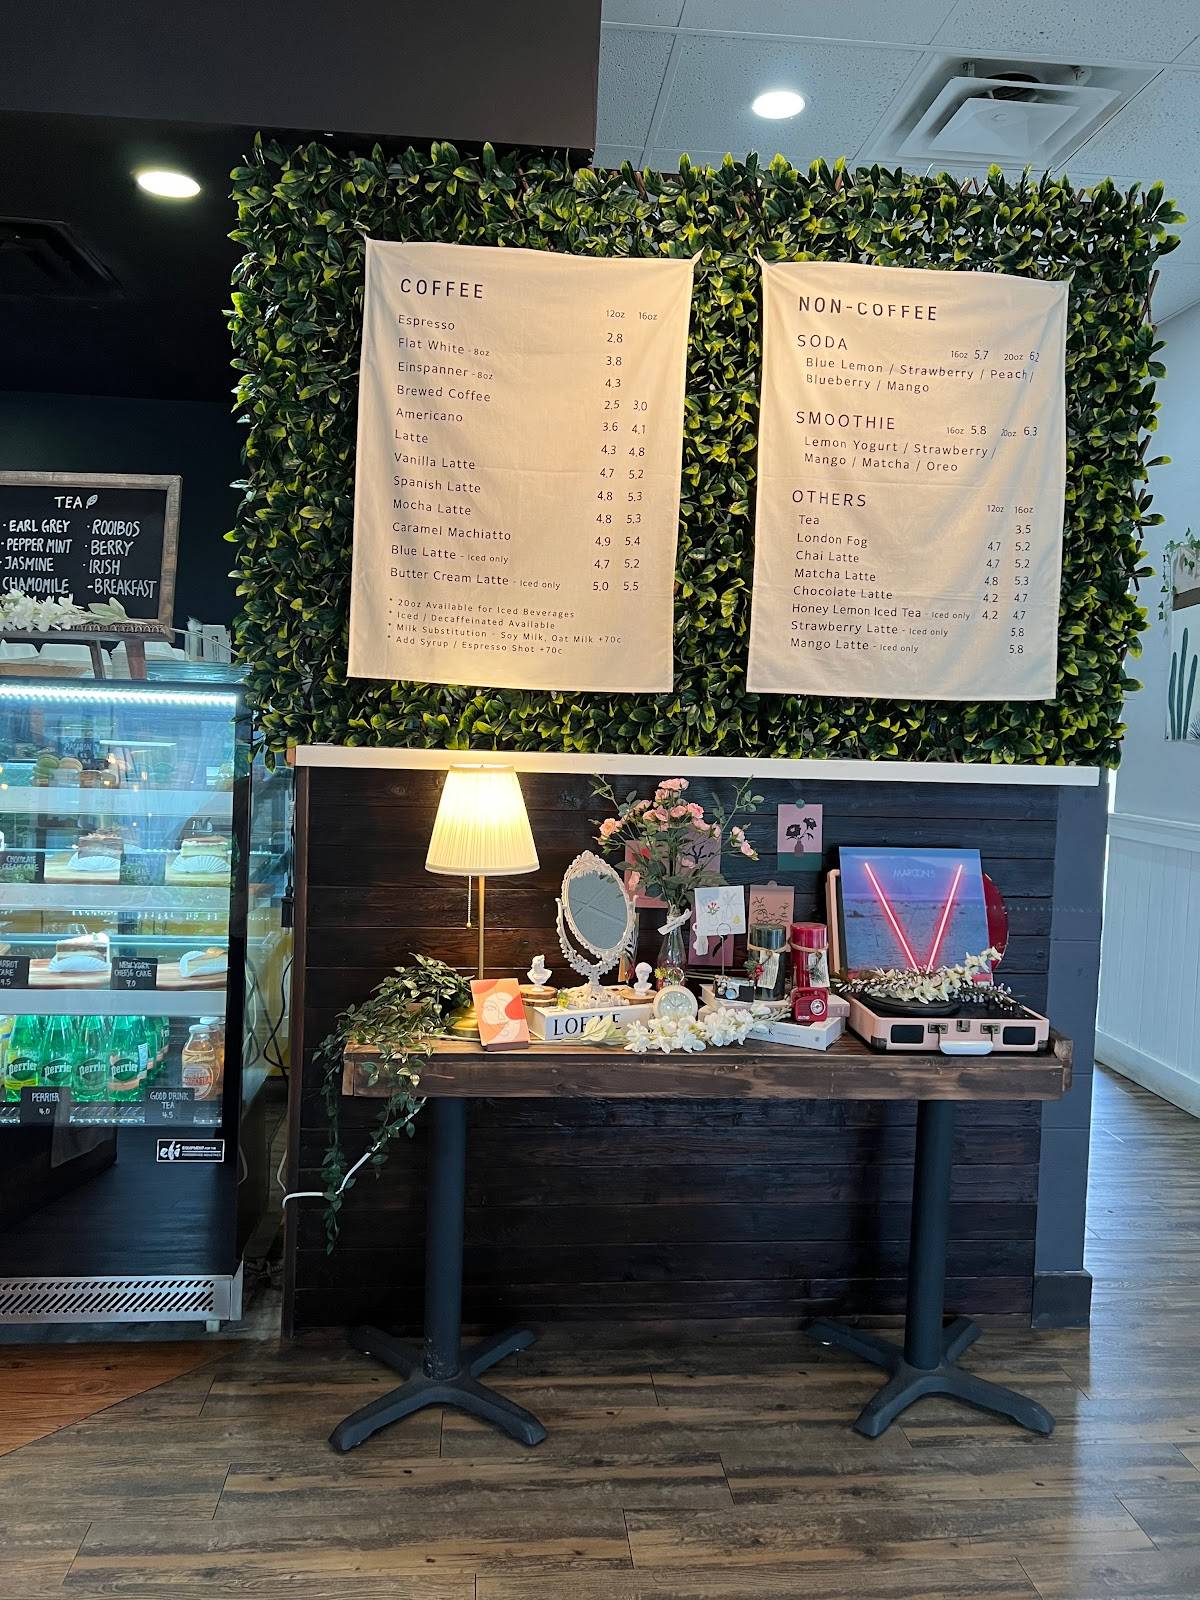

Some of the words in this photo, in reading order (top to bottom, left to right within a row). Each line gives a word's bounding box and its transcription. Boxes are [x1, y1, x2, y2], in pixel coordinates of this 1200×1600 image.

[401, 278, 483, 298] COFFEE
[606, 310, 625, 318] 12oz
[639, 312, 657, 320] 16oz
[799, 296, 936, 320] NON-COFFEE
[398, 315, 454, 330] Espresso
[607, 333, 622, 343] 2.8
[798, 334, 848, 350] SODA
[399, 337, 422, 348] Flat
[428, 340, 464, 354] White
[606, 356, 622, 366] 3.8
[952, 350, 968, 358] 16oz
[974, 350, 988, 360] 5.7
[398, 362, 468, 378] Einspanner
[806, 357, 834, 368] Blue
[842, 360, 882, 372] Lemon
[900, 366, 973, 380] Strawberry
[991, 369, 1027, 380] Peach
[605, 378, 620, 388] 4.3
[807, 374, 870, 390] Blueberry
[888, 381, 929, 394] Mango
[398, 385, 442, 396] Brewed
[448, 389, 490, 402] Coffee
[604, 400, 619, 410] 2.5
[634, 400, 647, 411] 3.0
[396, 408, 462, 422] Americano
[796, 411, 894, 430] SMOOTHIE
[603, 422, 618, 431] 3.6
[632, 424, 645, 434] 4.1
[971, 426, 986, 435] 5.8
[1024, 426, 1037, 436] 6.3
[396, 429, 428, 443] Latte
[601, 444, 616, 454] 4.3
[629, 447, 644, 457] 4.8
[805, 436, 846, 448] Lemon
[853, 440, 898, 455] Yogurt
[914, 444, 987, 458] Strawberry
[394, 452, 436, 466] Vanilla
[442, 458, 475, 470] Latte
[805, 453, 846, 467] Mango
[862, 458, 909, 469] Matcha
[927, 462, 957, 471] Oreo
[600, 468, 614, 478] 4.7
[629, 469, 643, 479] 5.2
[394, 475, 441, 490] Spanish
[448, 481, 480, 493] Latte
[54, 496, 83, 509] TEA
[598, 491, 612, 501] 4.8
[628, 492, 642, 502] 5.3
[792, 490, 866, 507] OTHERS
[394, 499, 432, 512] Mocha
[438, 504, 471, 515] Latte
[988, 505, 1004, 513] 12oz
[1015, 506, 1033, 514] 16oz
[9, 519, 38, 533] EARL
[41, 519, 71, 533] GREY
[596, 514, 611, 524] 4.8
[626, 514, 641, 524] 5.3
[798, 515, 819, 525] Tea
[92, 519, 140, 538] ROOIBOS
[393, 522, 442, 536] Caramel
[448, 528, 510, 540] Machiatto
[1016, 524, 1031, 534] 3.5
[7, 538, 44, 552] PEPPER
[46, 539, 73, 554] MINT
[595, 537, 610, 547] 4.9
[625, 536, 640, 546] 5.4
[798, 532, 841, 544] London
[847, 536, 867, 548] Fog
[988, 542, 1001, 551] 4.7
[1016, 542, 1030, 551] 5.2
[90, 540, 134, 556] BERRY
[392, 545, 416, 556] Blue
[423, 547, 456, 559] Latte
[489, 556, 509, 565] only
[796, 550, 823, 560] Chai
[829, 552, 859, 563] Latte
[986, 558, 1000, 568] 4.7
[1015, 559, 1030, 568] 5.2
[4, 556, 54, 572] JASMINE
[89, 559, 121, 576] IRISH
[594, 560, 610, 569] 4.7
[625, 559, 639, 568] 5.2
[391, 568, 428, 579] Butter
[434, 571, 471, 582] Cream
[477, 574, 508, 585] Latte
[795, 568, 840, 578] Matcha
[846, 570, 875, 581] Latte
[984, 576, 998, 586] 4.8
[1015, 576, 1028, 586] 5.3
[2, 576, 69, 594] CHAMOMILE
[593, 582, 608, 591] 5.0
[624, 581, 638, 591] 5.5
[794, 586, 856, 597] Chocolate
[861, 589, 892, 599] Latte
[983, 593, 998, 602] 4.2
[1014, 593, 1028, 603] 4.7
[398, 599, 421, 607] 20oz
[426, 602, 472, 611] Available
[523, 608, 574, 619] Beverages
[793, 603, 828, 616] Honey
[833, 604, 870, 615] Lemon
[874, 606, 897, 616] Iced
[902, 608, 921, 617] Tea
[982, 610, 998, 620] 4.2
[1013, 610, 1026, 620] 4.7
[432, 614, 503, 626] Decaffeinated
[509, 620, 554, 629] Available
[397, 624, 416, 632] Milk
[422, 626, 486, 637] Substitution
[501, 632, 518, 641] Soy
[792, 621, 862, 637] Strawberry
[867, 624, 898, 634] Latte
[1011, 628, 1024, 637] 5.8
[396, 636, 414, 644] Add
[421, 638, 448, 648] Syrup
[462, 642, 506, 651] Espresso
[512, 644, 534, 652] Shot
[791, 638, 830, 650] Mango
[836, 640, 868, 650] Latte
[1010, 644, 1023, 654] 5.8
[31, 1092, 60, 1103] PERRIER
[150, 1091, 167, 1101] GOOD
[161, 1101, 175, 1110] TEA
